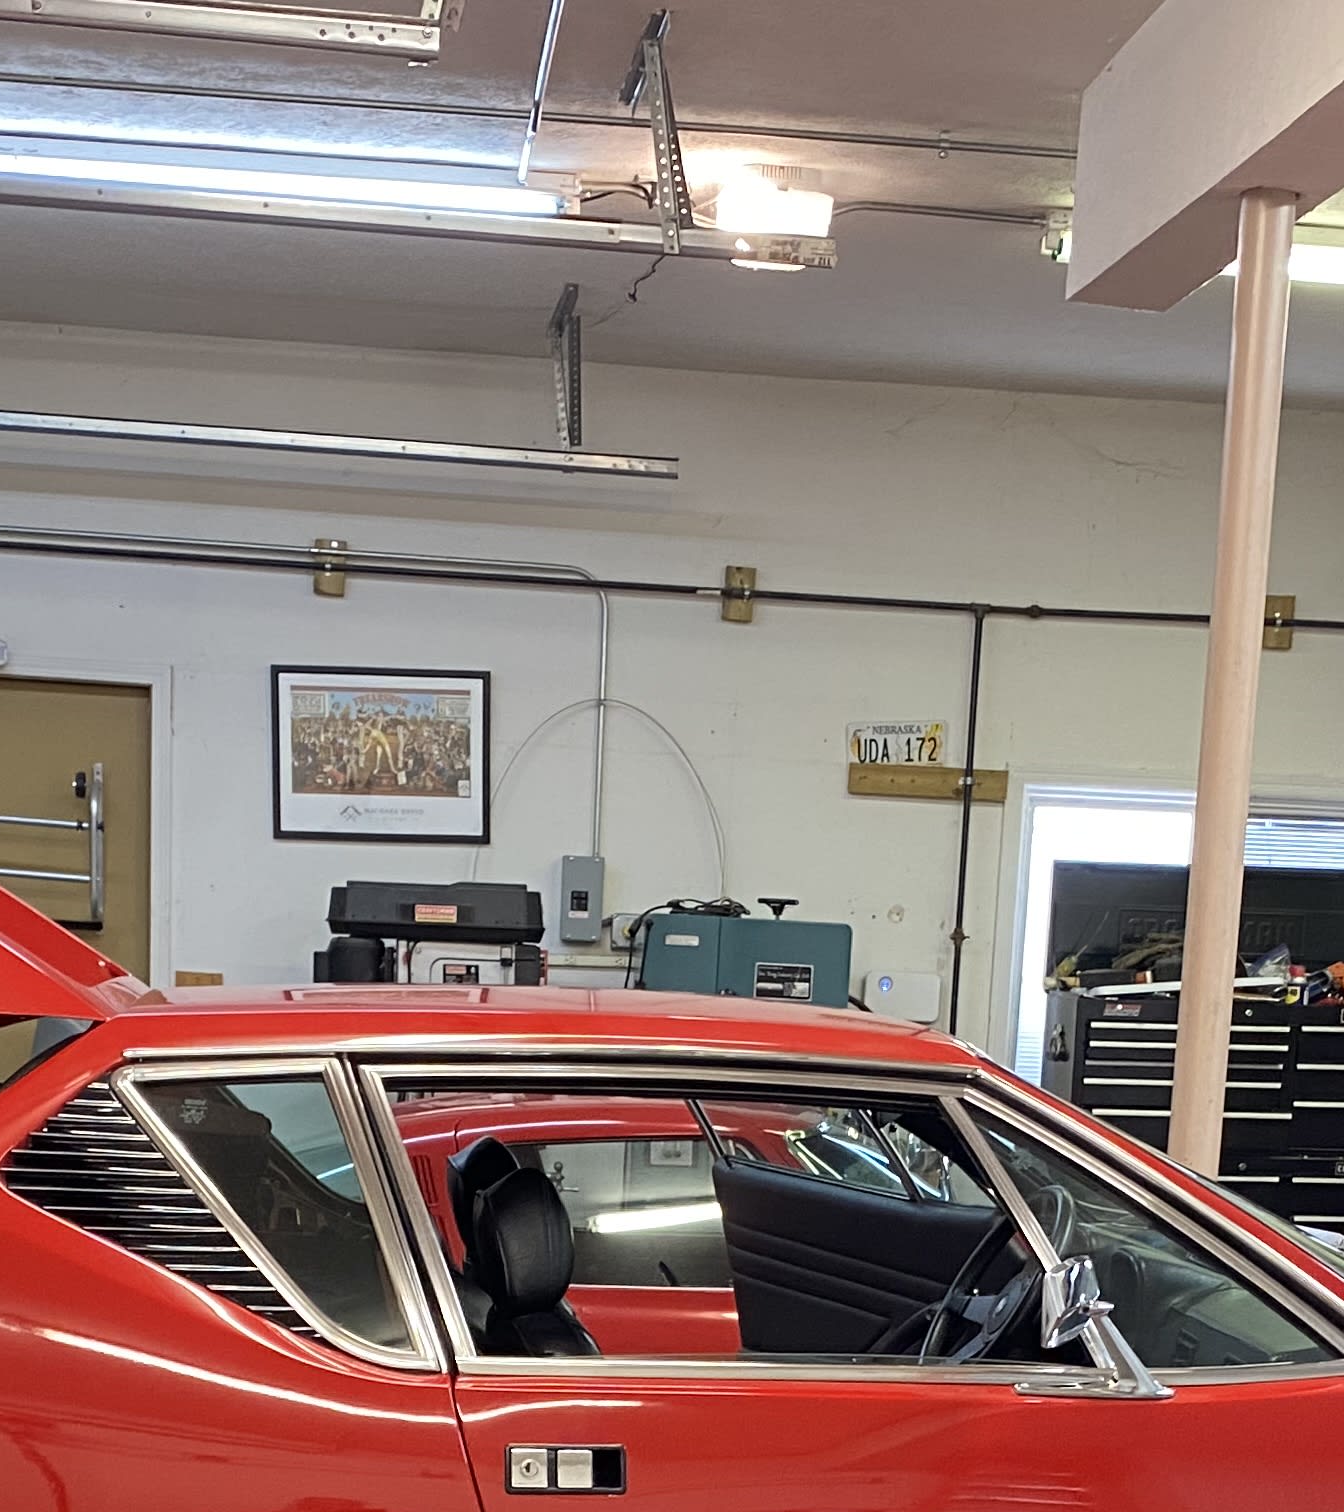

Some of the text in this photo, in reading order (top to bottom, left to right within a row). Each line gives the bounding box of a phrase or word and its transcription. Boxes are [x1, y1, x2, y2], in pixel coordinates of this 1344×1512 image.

[872, 724, 922, 735] NEBRASKA
[857, 737, 938, 764] UDA 172
